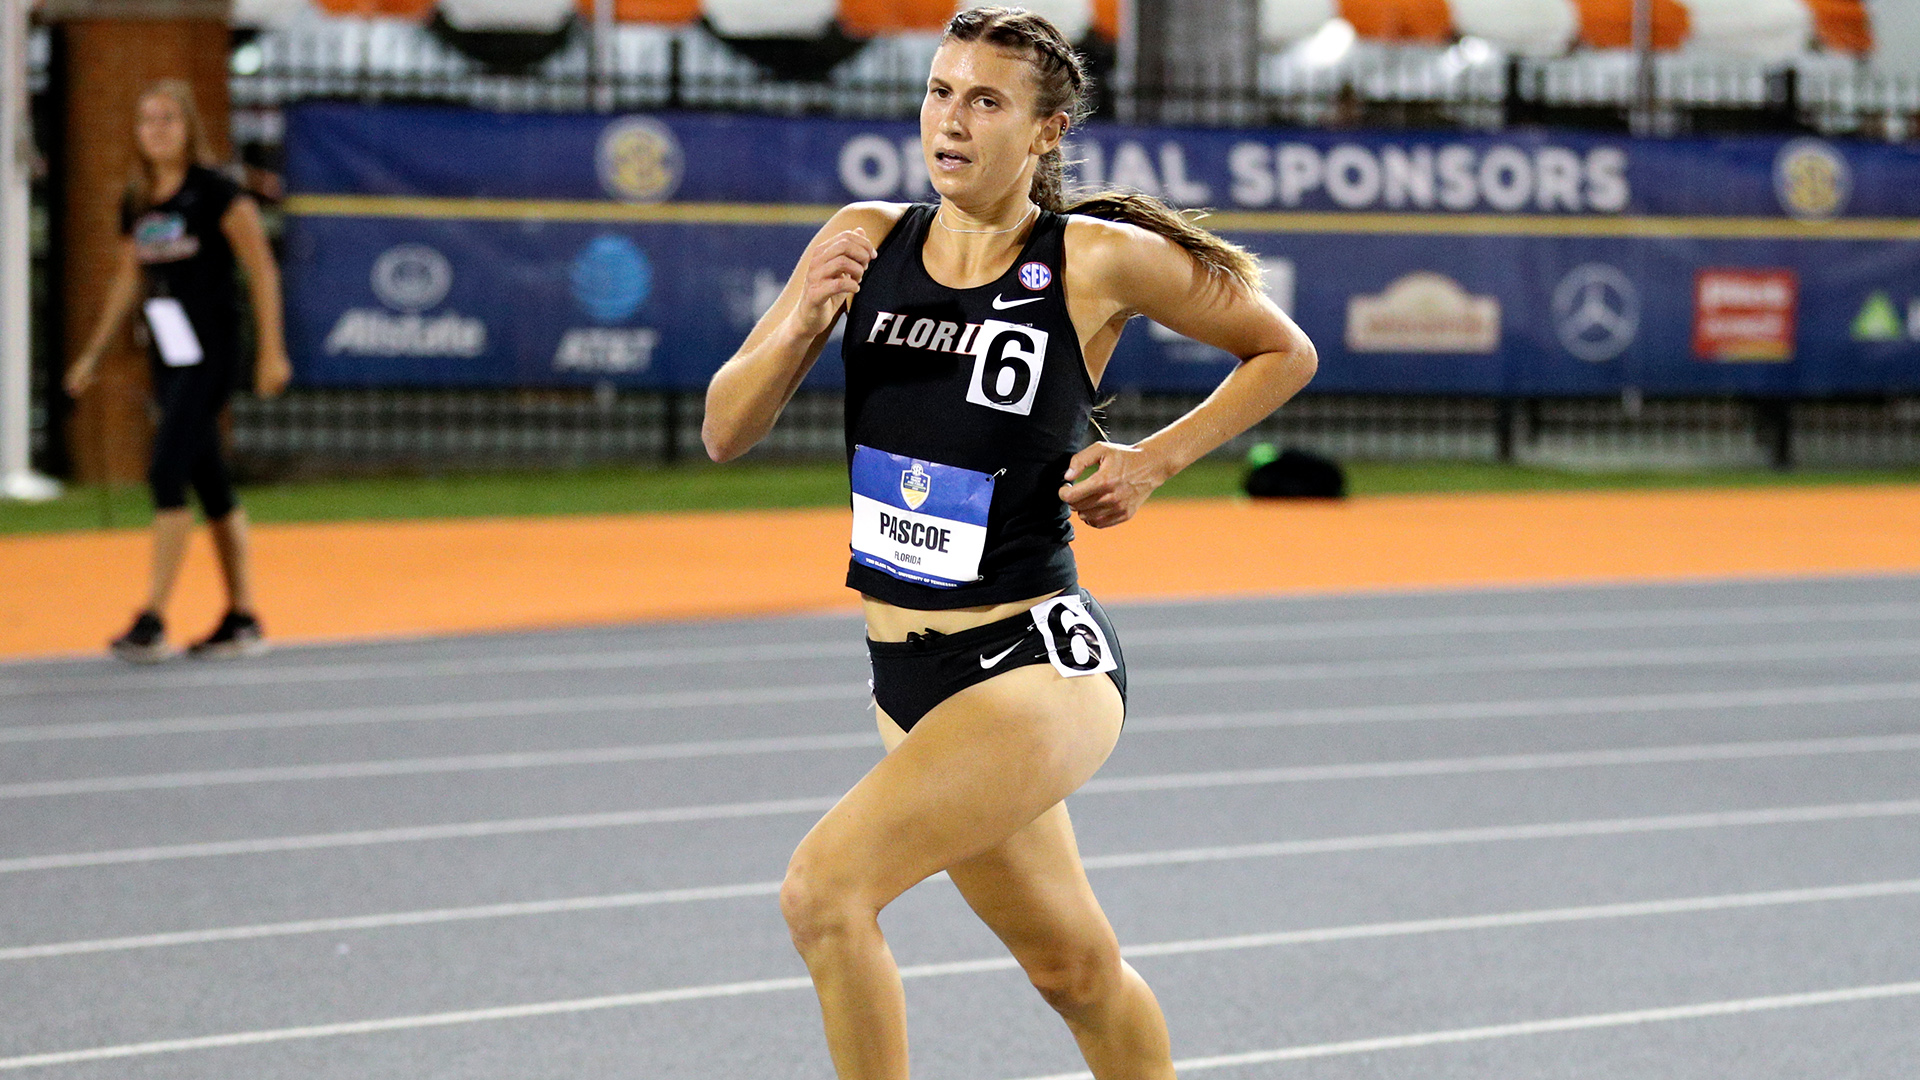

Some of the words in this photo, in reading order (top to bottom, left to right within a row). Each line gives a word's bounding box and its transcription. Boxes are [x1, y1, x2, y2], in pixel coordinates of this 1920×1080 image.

[1228, 142, 1630, 212] SPONSORS
[1020, 263, 1050, 289] SEC
[866, 311, 984, 355] FLORI
[981, 330, 1035, 405] 6
[880, 512, 951, 553] PASCOE
[894, 551, 922, 565] FLORIDA
[1048, 602, 1102, 671] 6
